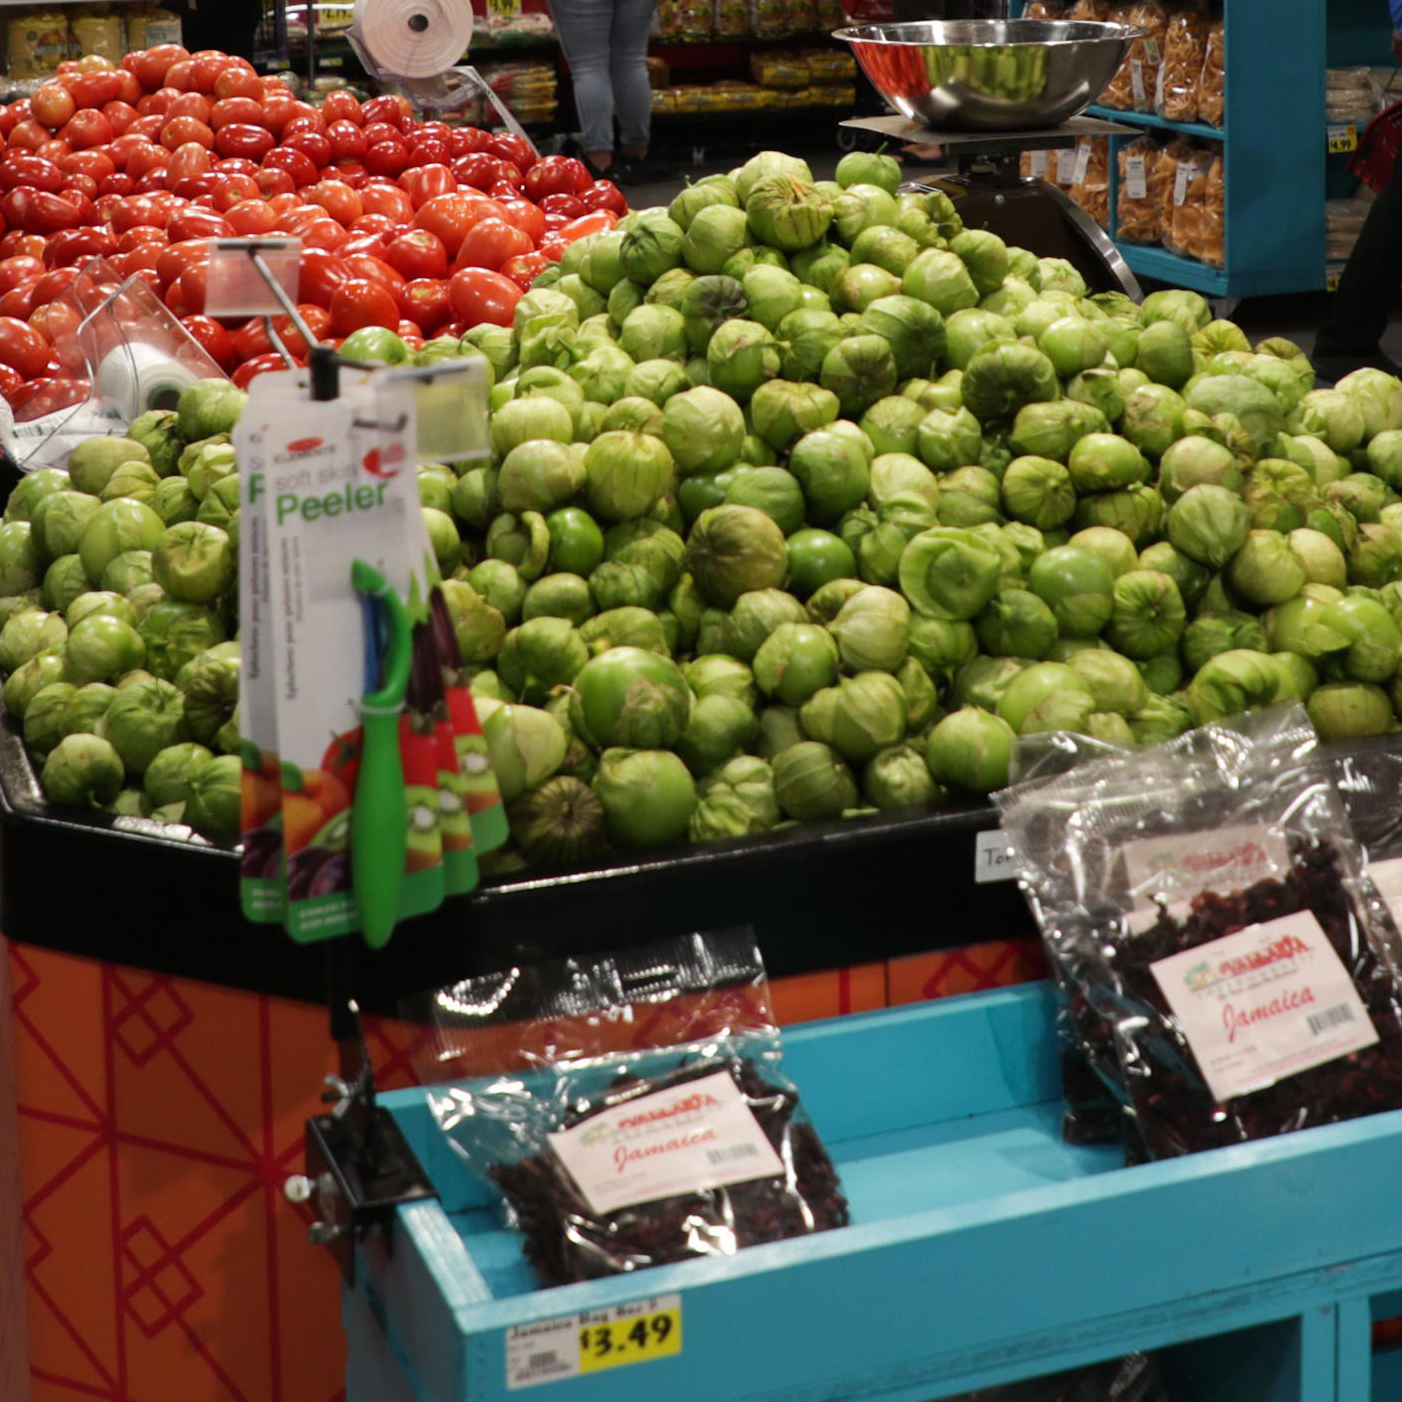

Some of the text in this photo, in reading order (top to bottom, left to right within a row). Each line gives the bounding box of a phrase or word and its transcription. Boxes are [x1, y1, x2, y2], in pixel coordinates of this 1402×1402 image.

[276, 481, 389, 526] Peeler
[1222, 986, 1316, 1044] Jamaica
[613, 1127, 718, 1173] Jamaica
[580, 1314, 673, 1358] $3.49
